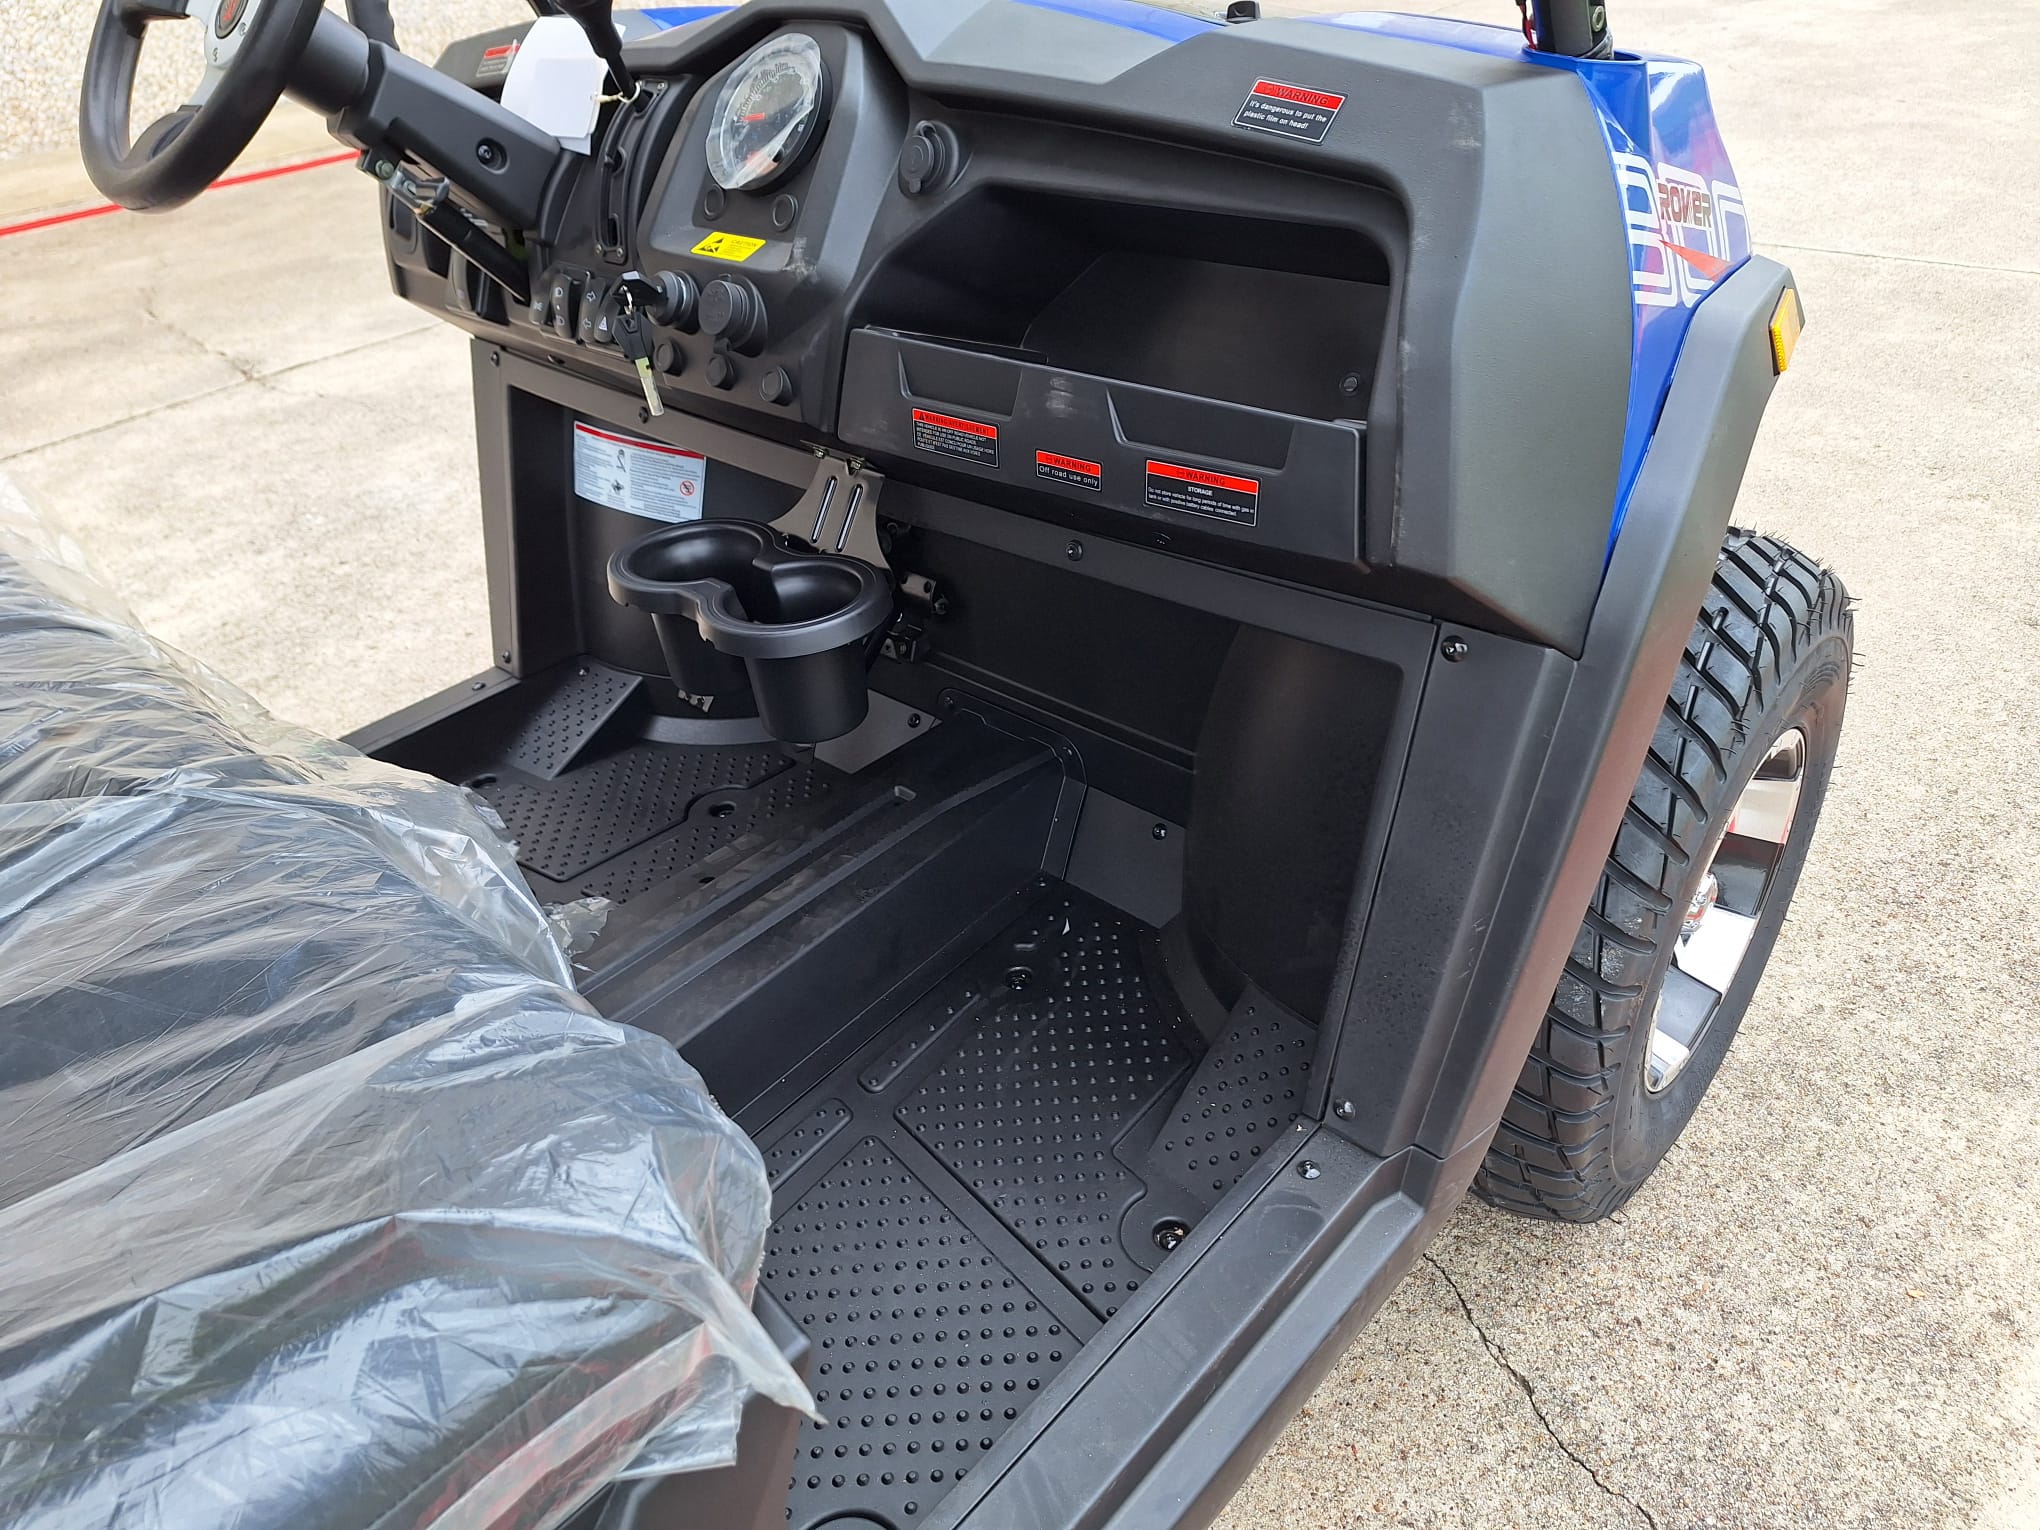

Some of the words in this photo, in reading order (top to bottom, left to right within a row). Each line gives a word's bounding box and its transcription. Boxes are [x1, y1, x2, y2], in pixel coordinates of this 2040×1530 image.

[1276, 87, 1329, 105] WARNING
[1243, 110, 1266, 120] plastic
[1266, 114, 1278, 122] film
[1260, 103, 1294, 116] dangerous
[1315, 114, 1328, 122] the
[1658, 182, 1712, 228] ROVER
[1053, 456, 1092, 472] WARNING
[1051, 470, 1067, 478] road
[1083, 477, 1098, 486] only
[1186, 470, 1226, 486] WARNING
[1188, 486, 1212, 496] STORAGE
